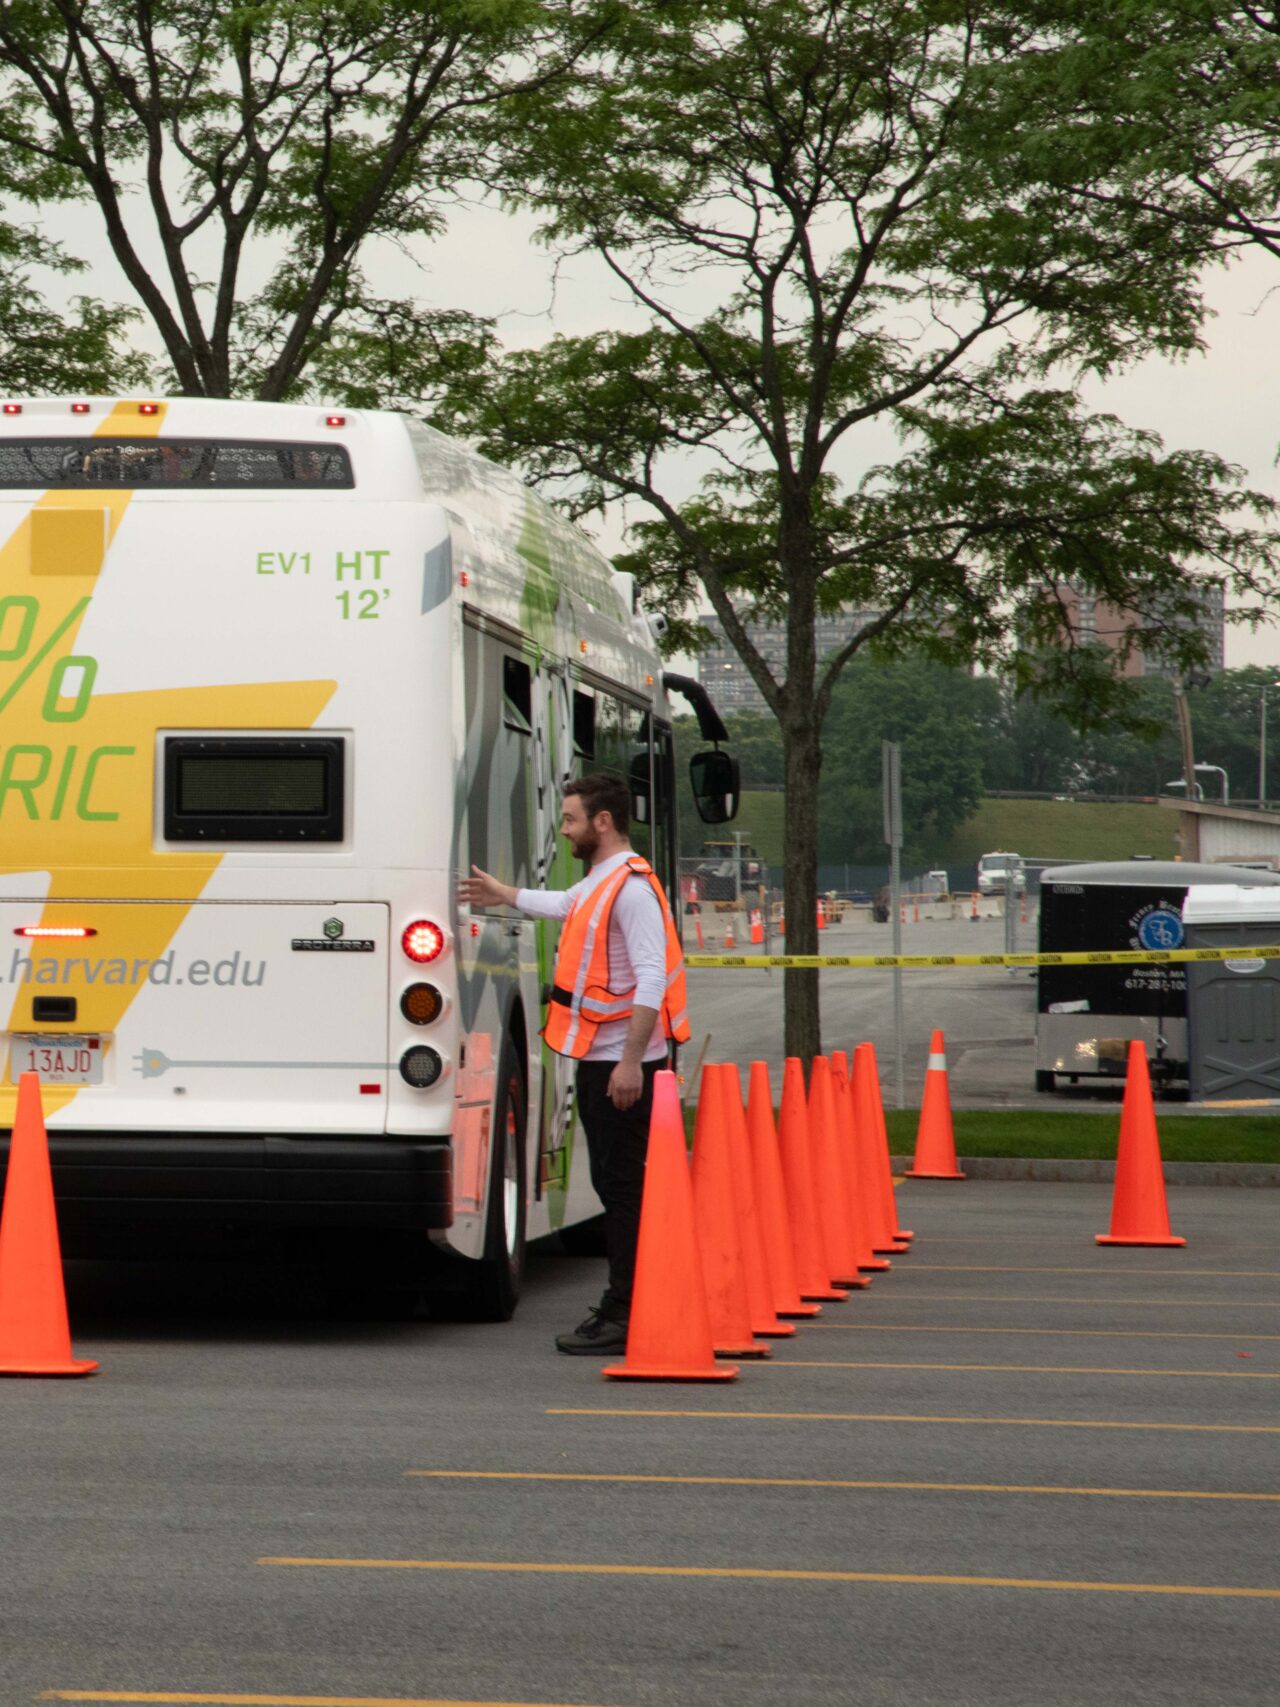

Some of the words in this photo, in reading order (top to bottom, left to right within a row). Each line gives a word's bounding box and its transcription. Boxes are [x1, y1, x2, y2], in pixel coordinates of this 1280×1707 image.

[256, 552, 312, 575] EV1
[335, 550, 391, 581] HT
[292, 940, 374, 951] PROTERRA
[27, 1049, 91, 1073] 13AJD
